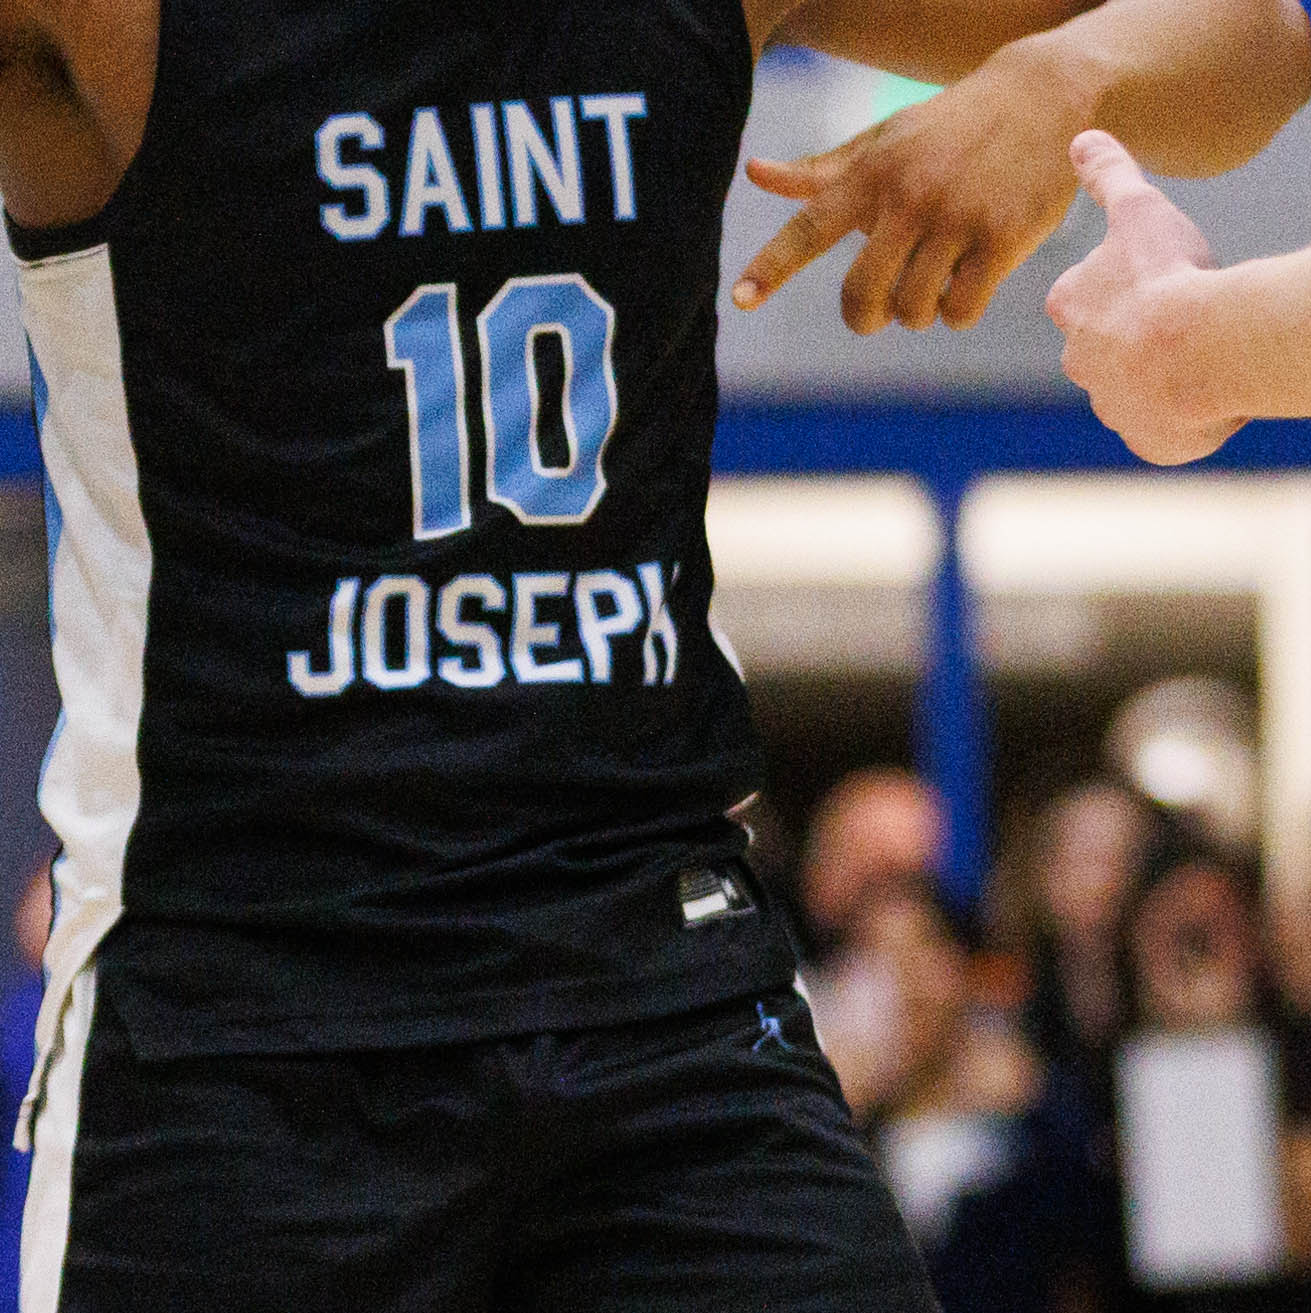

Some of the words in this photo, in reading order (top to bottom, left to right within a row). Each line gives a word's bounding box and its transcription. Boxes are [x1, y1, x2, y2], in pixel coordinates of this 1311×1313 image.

[314, 92, 647, 242] SAINT
[384, 274, 618, 541] 10
[288, 562, 681, 697] JOSEPH
